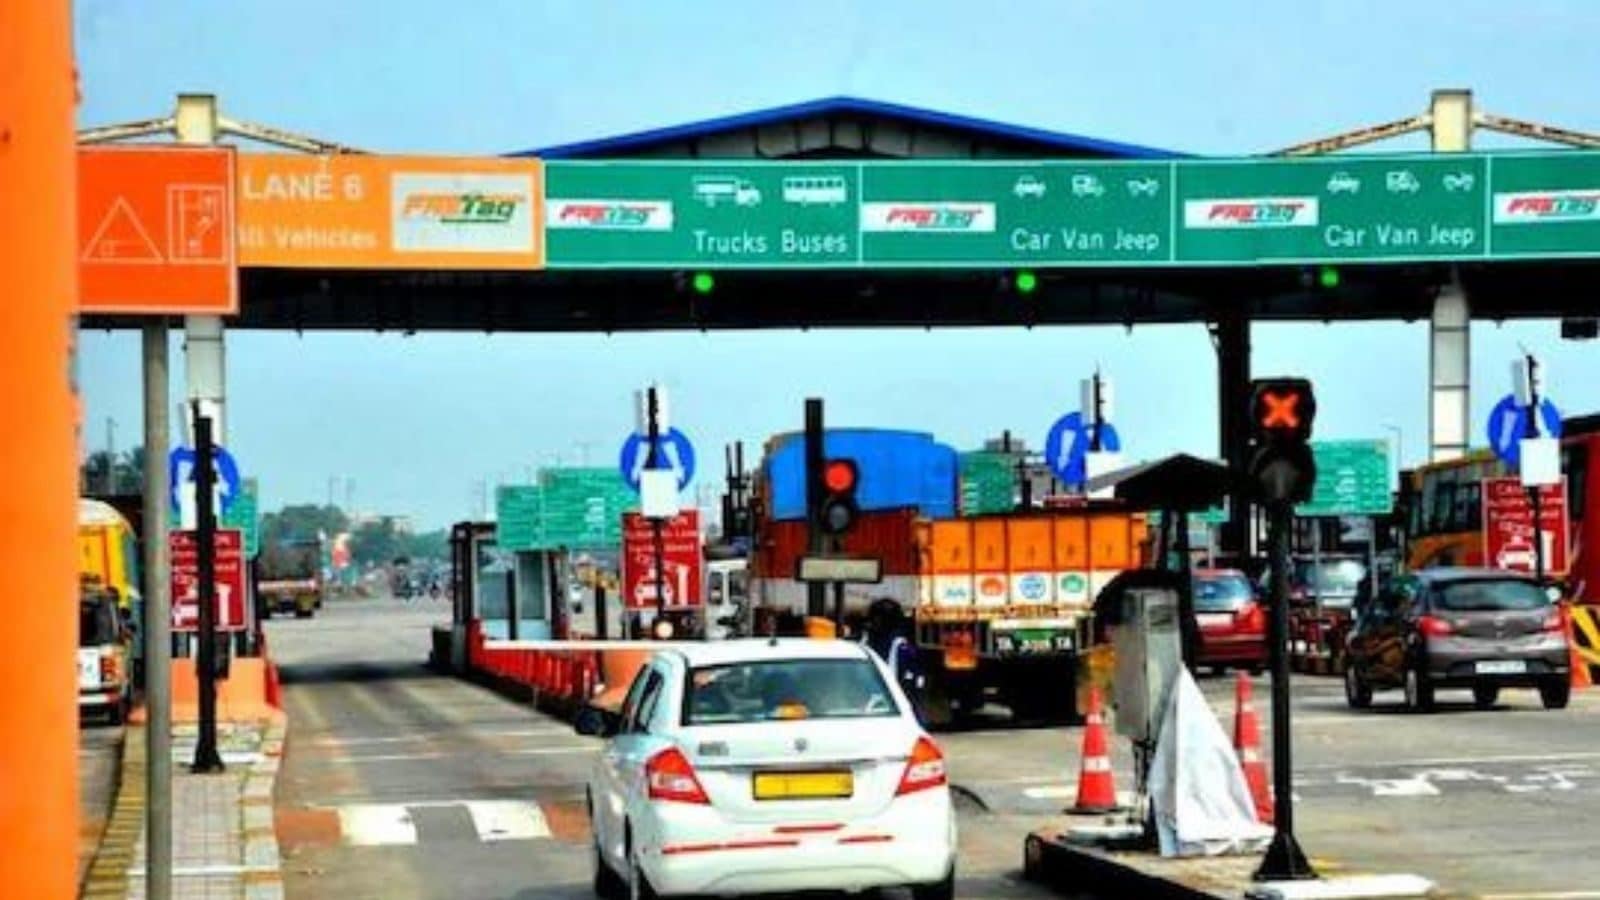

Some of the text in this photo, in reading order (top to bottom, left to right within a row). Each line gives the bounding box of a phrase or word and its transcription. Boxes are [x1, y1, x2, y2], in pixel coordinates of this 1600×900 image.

[241, 172, 364, 200] LANE 6
[272, 224, 378, 249] Vehicles
[693, 229, 848, 253] Trucks Buses
[1010, 227, 1160, 252] Car Van Jeep
[1325, 223, 1475, 249] Car Van Jeep
